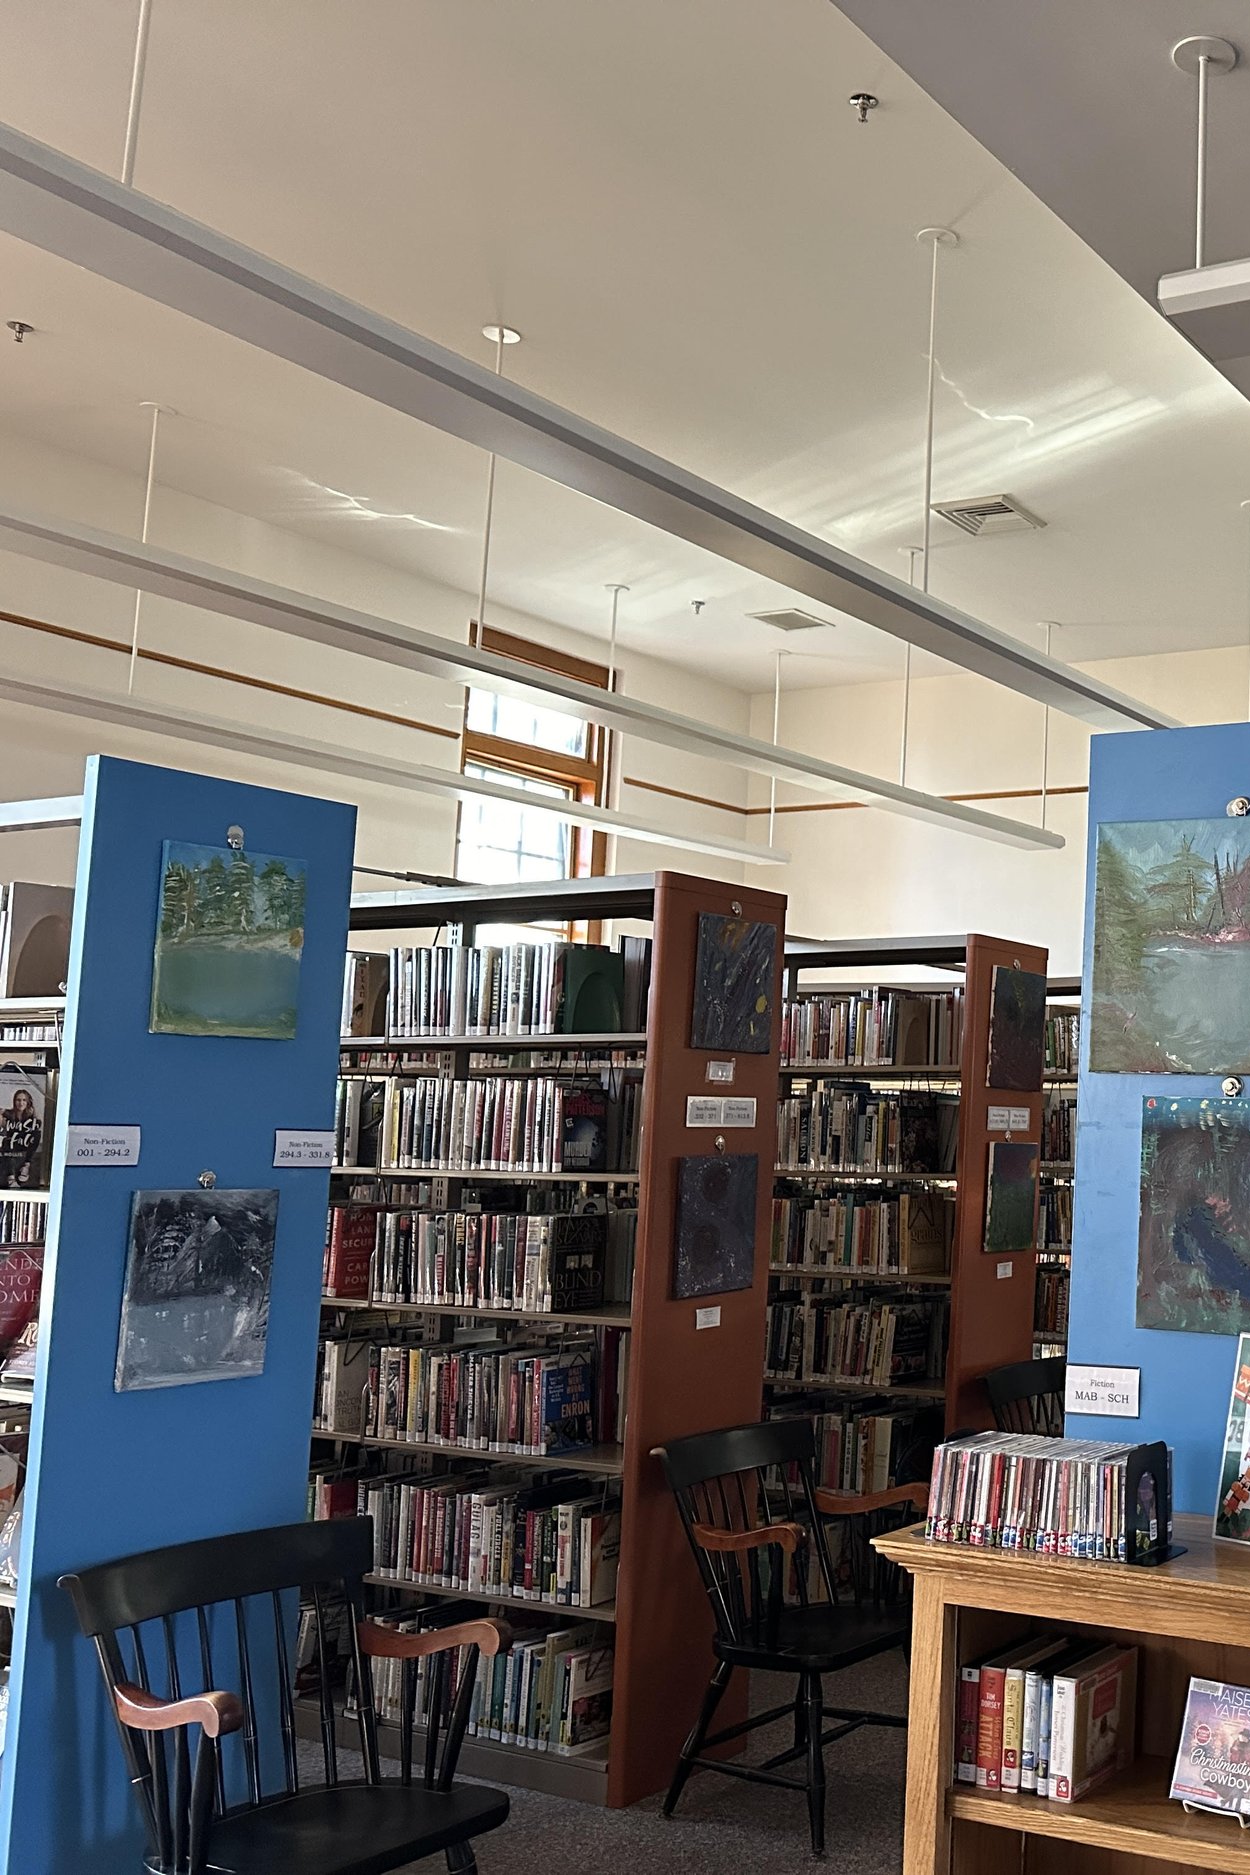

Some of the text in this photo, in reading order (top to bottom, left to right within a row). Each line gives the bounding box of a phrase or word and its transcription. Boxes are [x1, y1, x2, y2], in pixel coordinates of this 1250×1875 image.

[6, 1118, 40, 1133] wash
[10, 1132, 35, 1150] face
[800, 1116, 808, 1159] SALMON
[77, 1148, 94, 1157] 001
[104, 1148, 130, 1157] 294.2
[280, 1150, 302, 1158] 294.3
[308, 1150, 330, 1158] 331.8
[0, 1274, 31, 1287] NTO
[555, 1270, 602, 1290] BLIND
[553, 1291, 575, 1309] EYE
[1090, 1379, 1115, 1388] Fiction
[1075, 1391, 1098, 1401] MAB
[1108, 1393, 1129, 1404] SCH
[561, 1400, 590, 1418] ENRON
[980, 1699, 1001, 1710] DORSEY
[1005, 1683, 1017, 1747] Santa Claus
[978, 1714, 993, 1759] ATTACK
